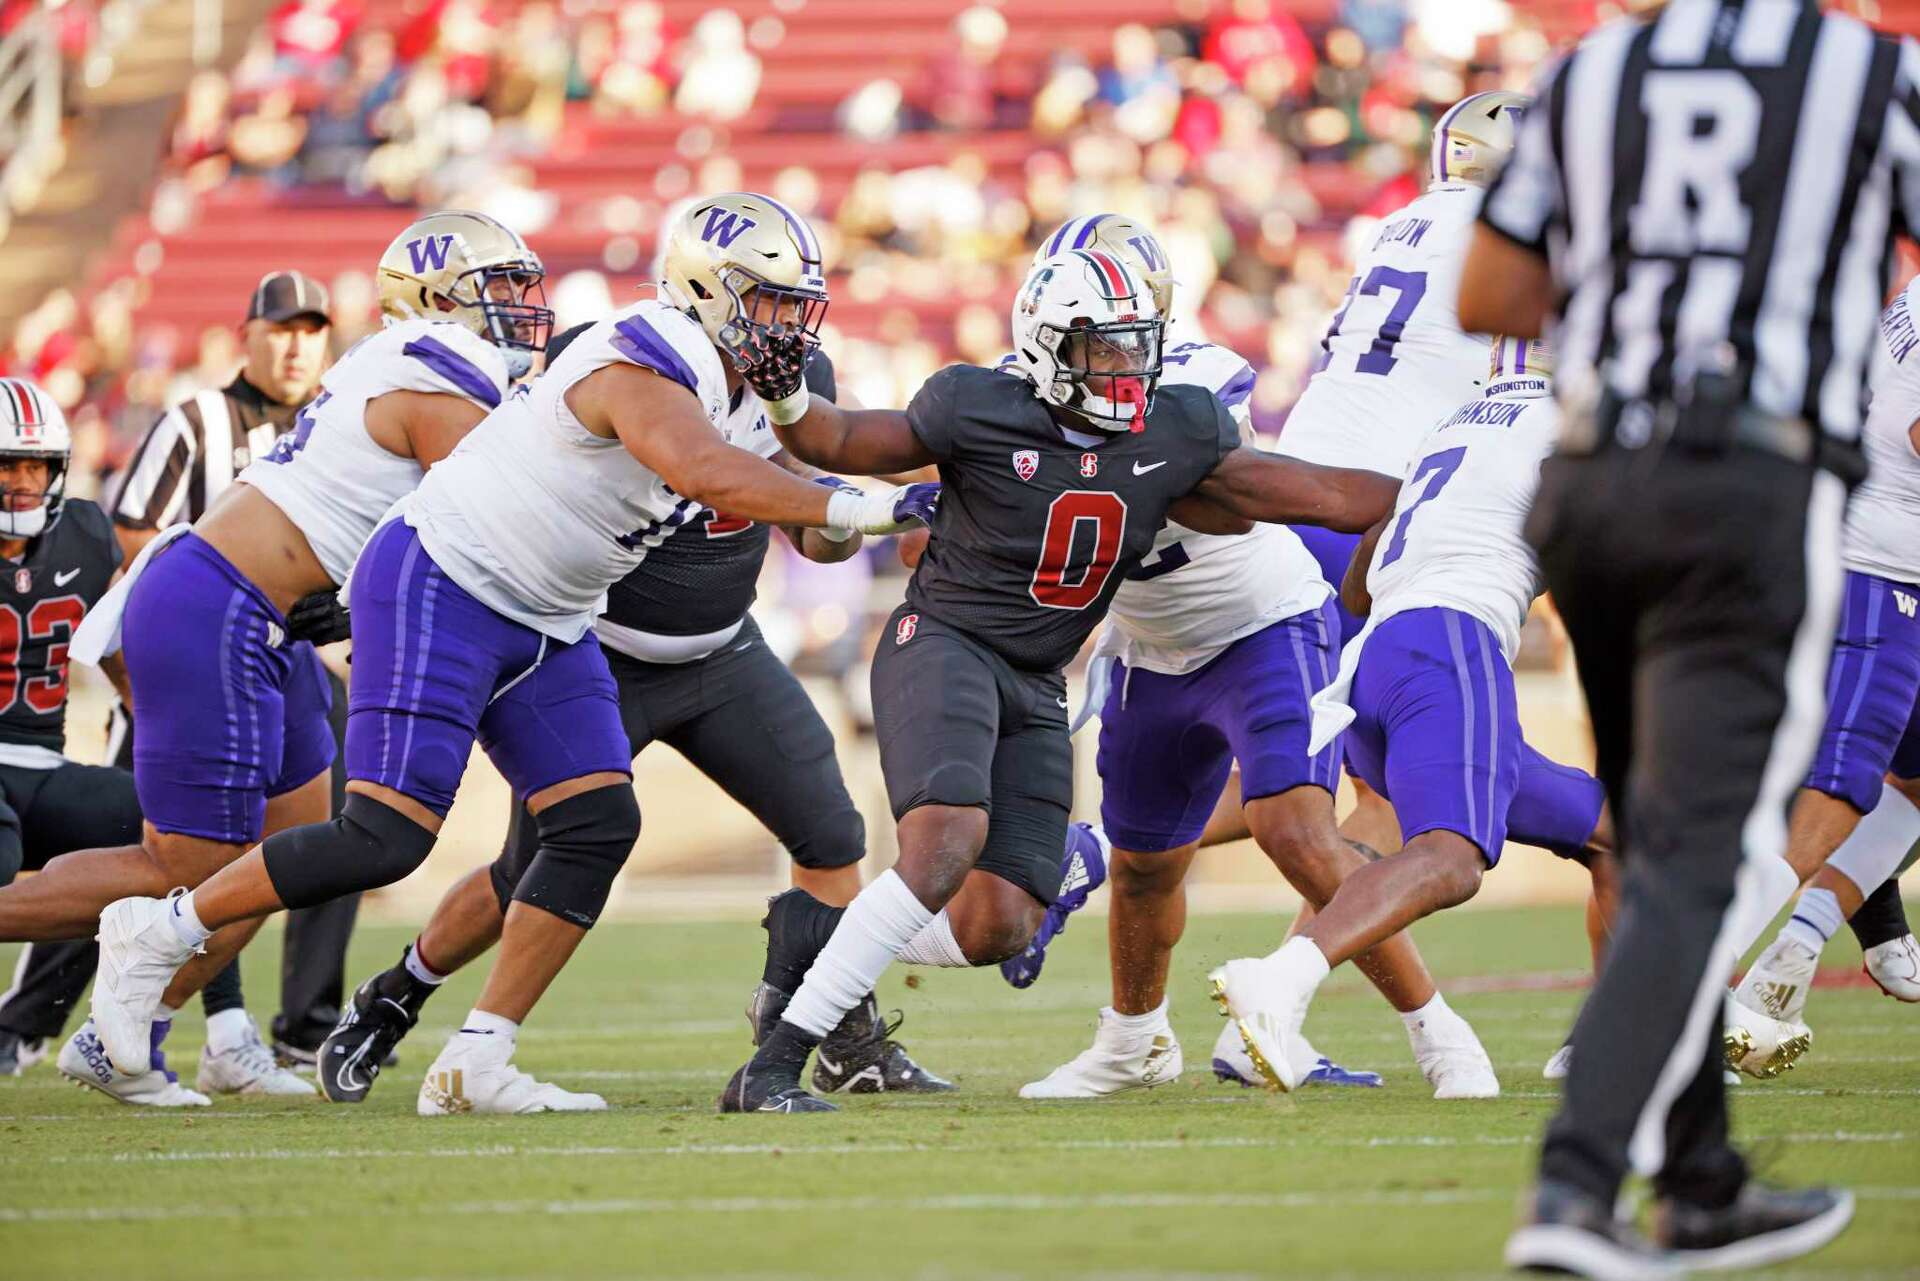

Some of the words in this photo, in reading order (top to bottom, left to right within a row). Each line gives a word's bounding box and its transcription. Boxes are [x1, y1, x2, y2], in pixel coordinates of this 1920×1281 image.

[1629, 68, 1763, 257] R
[702, 207, 757, 249] W
[406, 234, 454, 275] W
[1126, 235, 1166, 273] W
[1378, 445, 1468, 571] 7
[1029, 489, 1128, 611] 0
[1892, 590, 1919, 618] W
[74, 1034, 112, 1084] adidas
